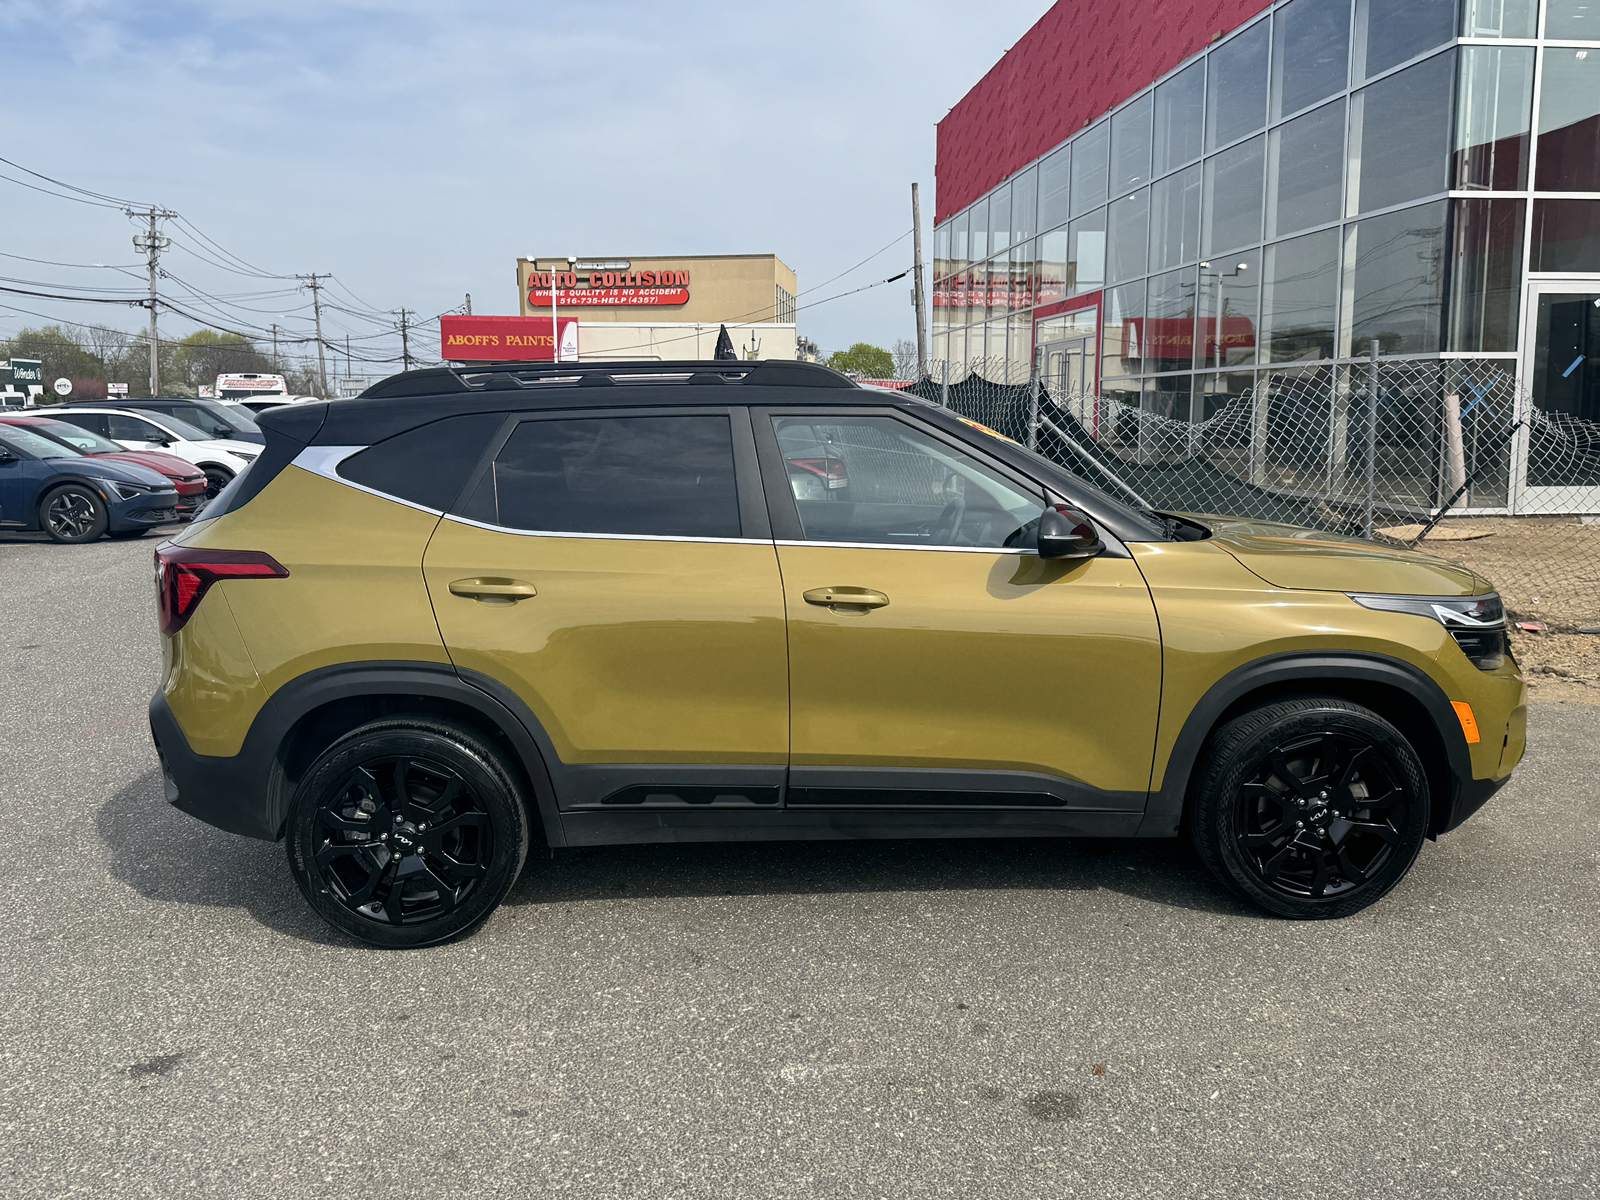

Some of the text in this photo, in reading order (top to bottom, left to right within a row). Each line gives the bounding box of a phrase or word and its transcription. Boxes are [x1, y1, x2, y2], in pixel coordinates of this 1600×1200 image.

[528, 270, 690, 288] AUTO COLLISION
[447, 334, 554, 346] ABOFF'S PAINTS
